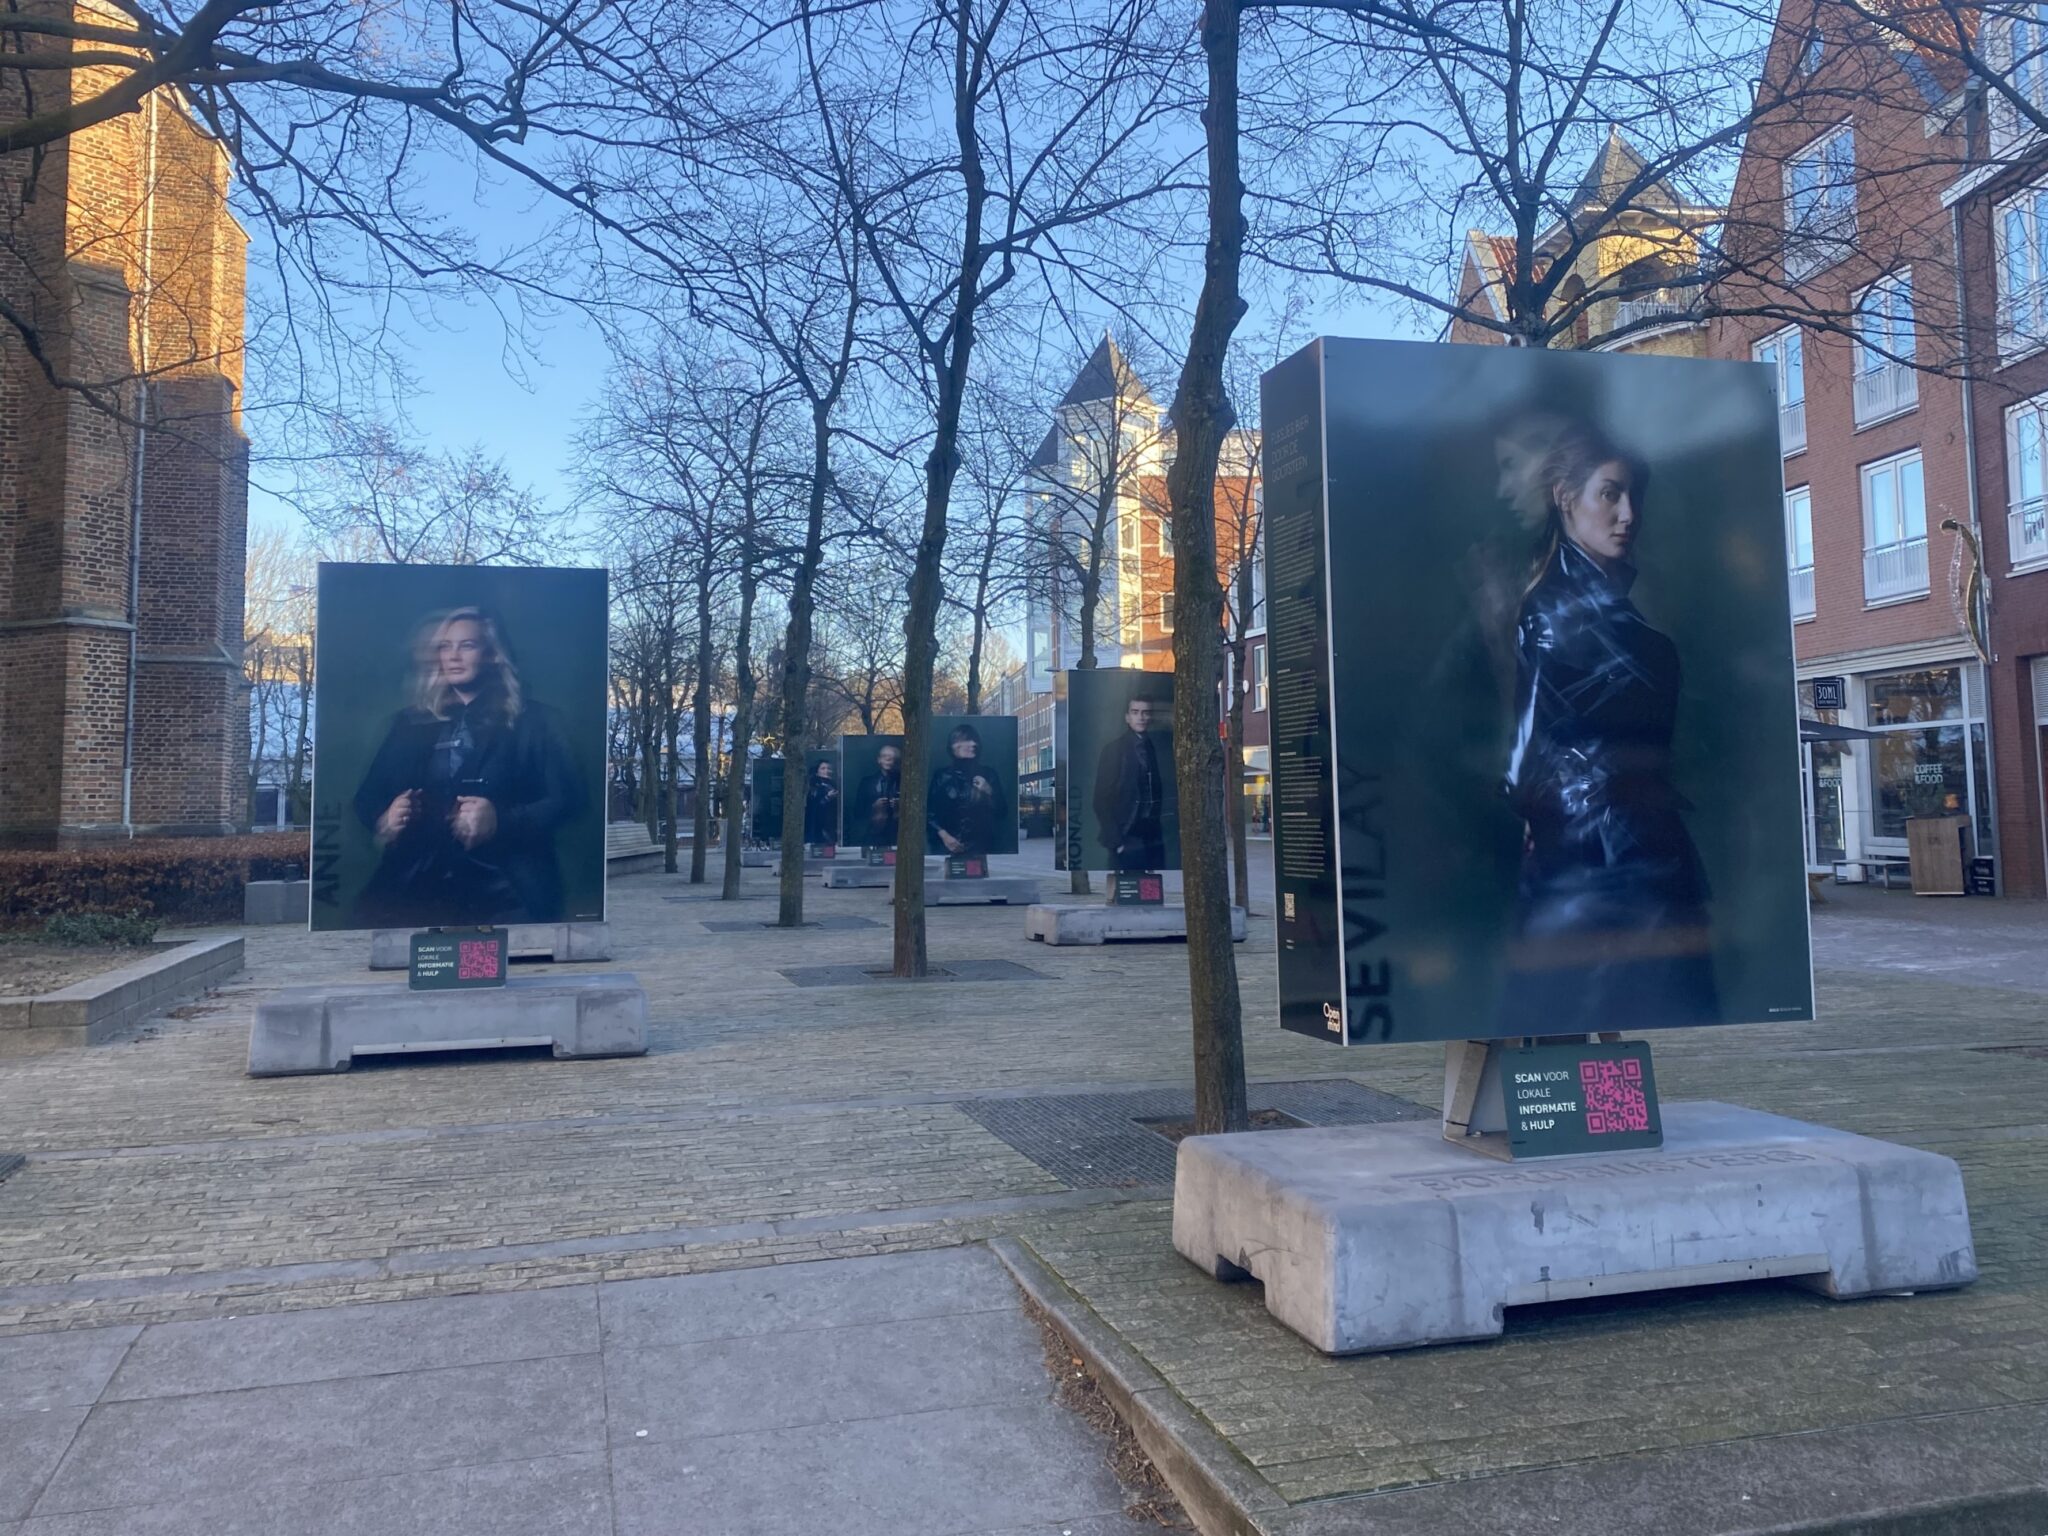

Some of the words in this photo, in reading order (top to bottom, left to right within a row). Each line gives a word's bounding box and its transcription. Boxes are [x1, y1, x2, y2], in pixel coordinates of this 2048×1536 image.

[1817, 686, 1838, 700] 30ML
[1914, 764, 1943, 774] COFFEE
[1915, 774, 1943, 785] &FOOD
[1069, 786, 1083, 870] RONALD
[313, 801, 342, 908] ANNE
[1339, 758, 1393, 1040] SEVILAY
[417, 945, 435, 953] SCAN
[417, 953, 439, 961] LOKALE
[417, 961, 454, 969] INFORMATIE
[1515, 1072, 1542, 1084] SCAN
[1543, 1071, 1570, 1082] VOOR
[1517, 1087, 1552, 1100] LOKALE
[1519, 1101, 1577, 1115] INFORMATIE
[1521, 1121, 1529, 1131] &
[1529, 1119, 1555, 1131] HULP
[1408, 1149, 1817, 1192] BORDBUSTERS
